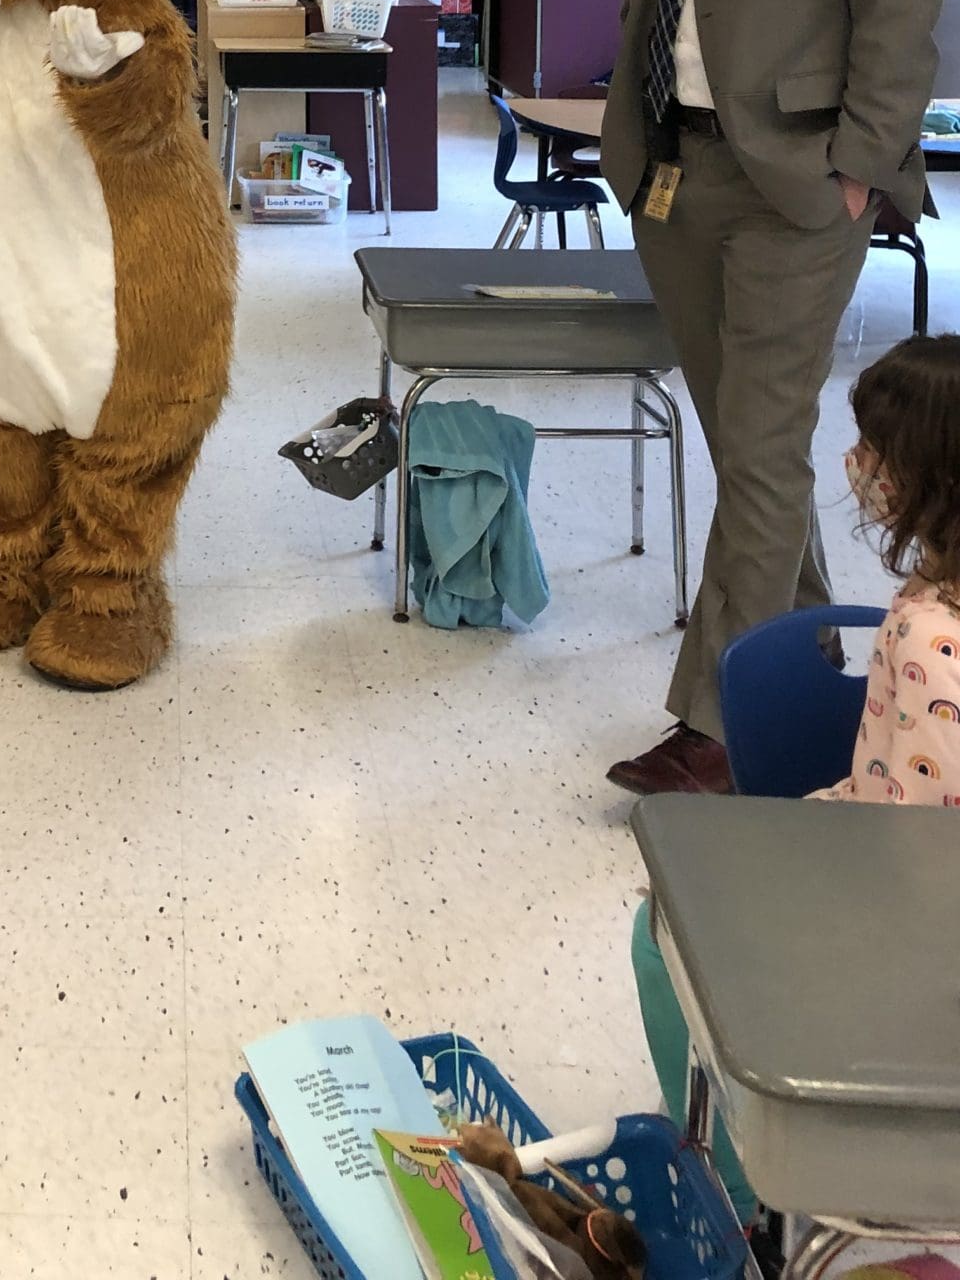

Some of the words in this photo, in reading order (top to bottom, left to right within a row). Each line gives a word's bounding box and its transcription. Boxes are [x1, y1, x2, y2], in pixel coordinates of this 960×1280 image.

[266, 197, 290, 207] book
[293, 198, 324, 207] return
[325, 1044, 355, 1056] March
